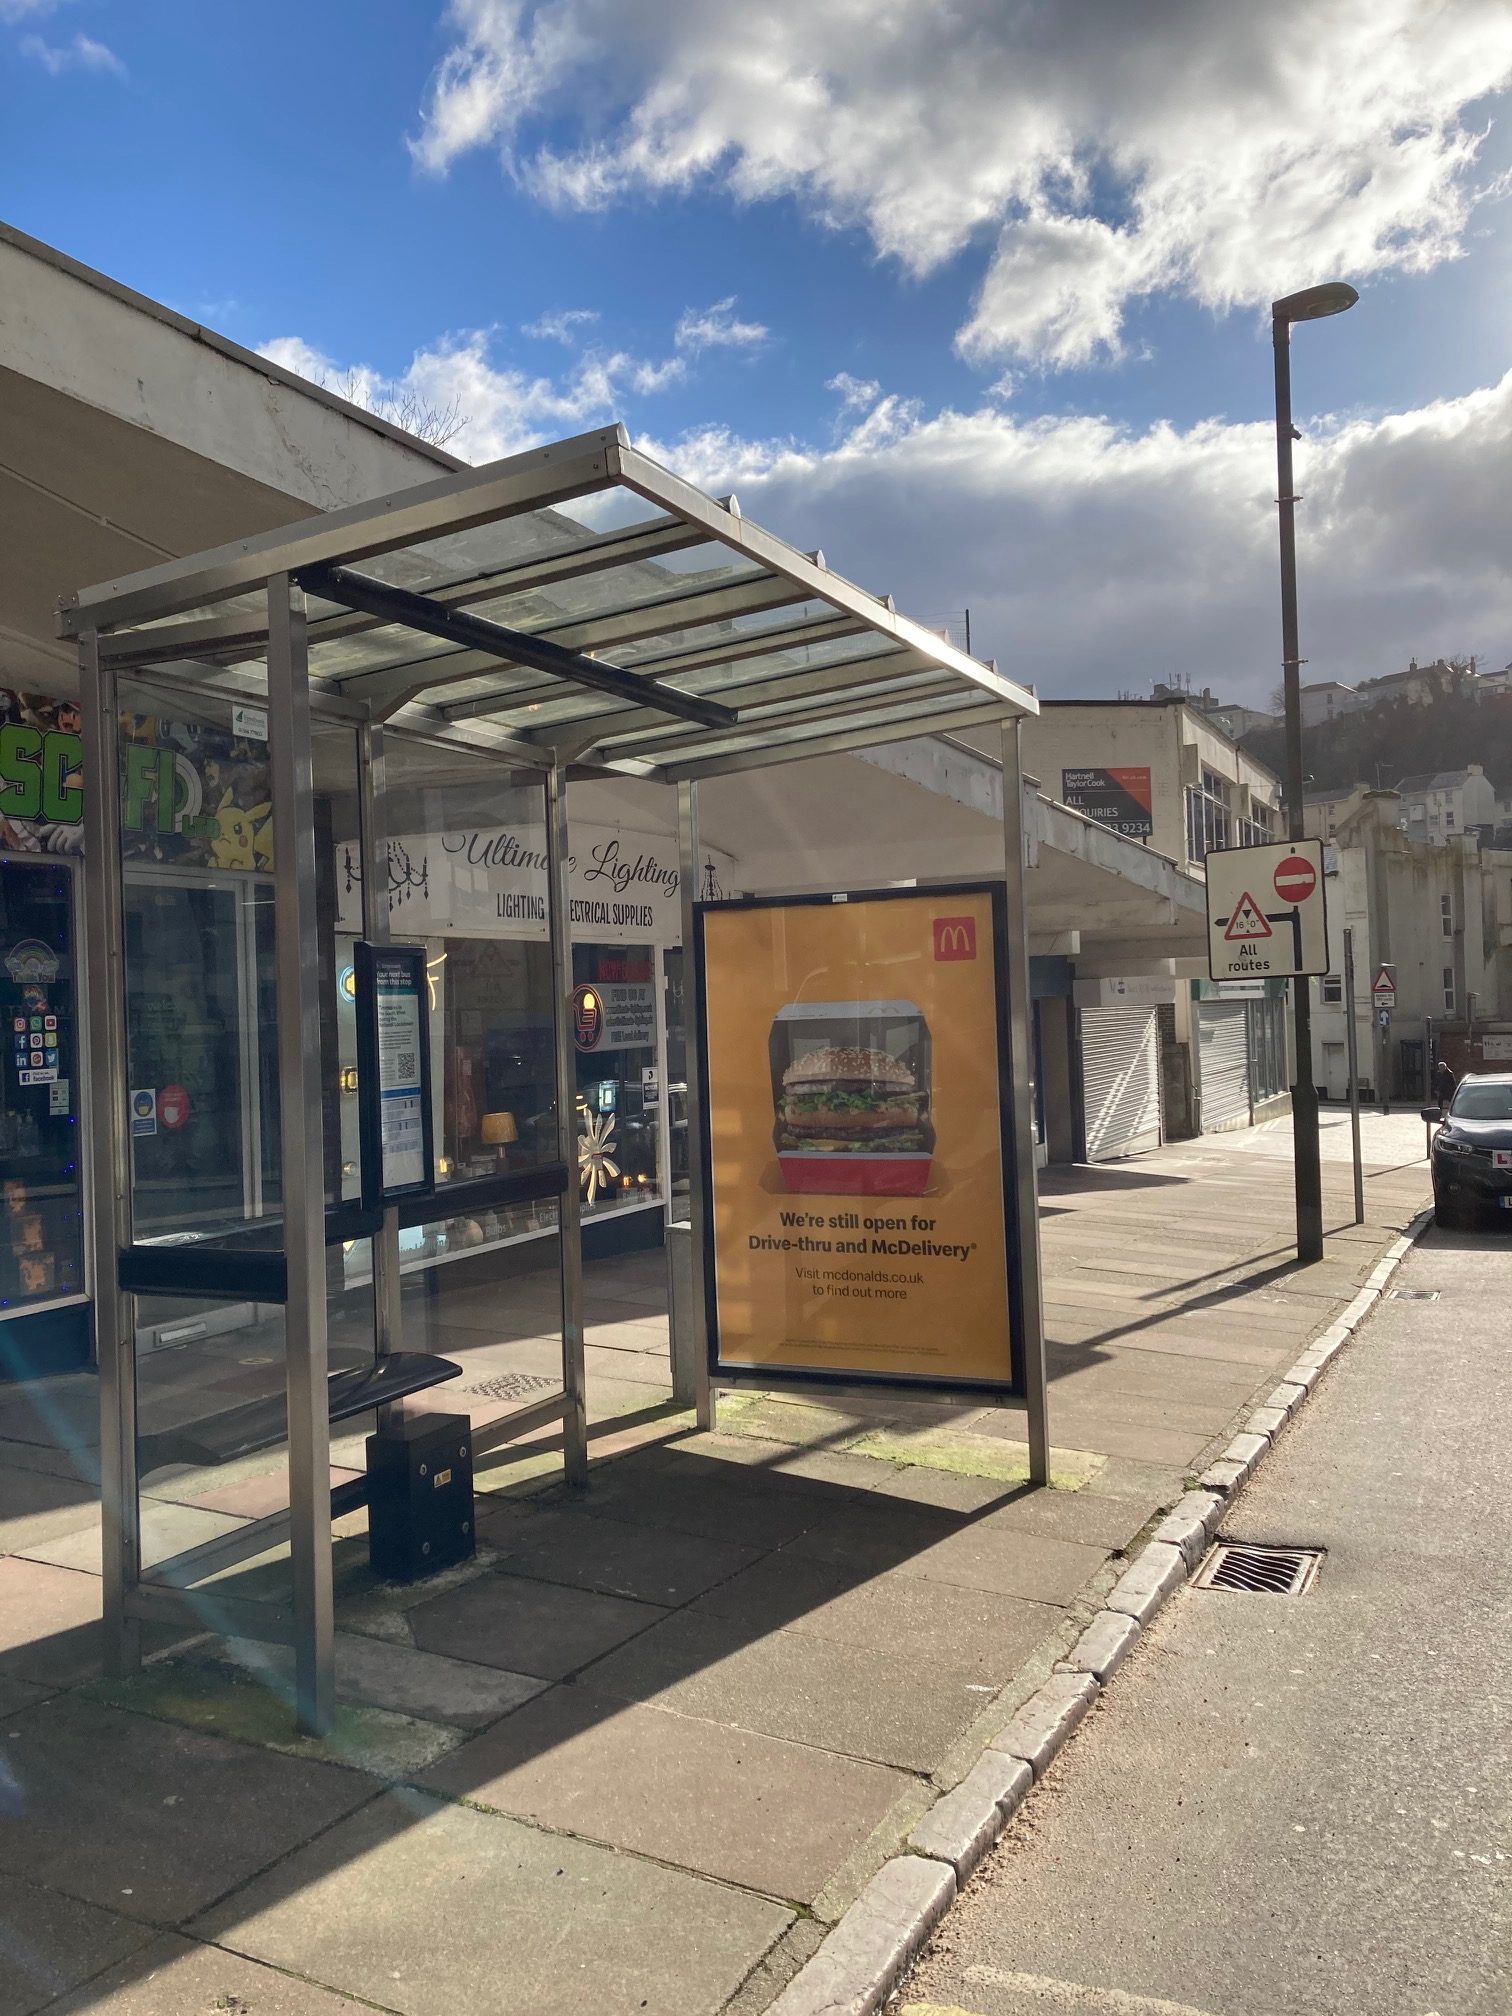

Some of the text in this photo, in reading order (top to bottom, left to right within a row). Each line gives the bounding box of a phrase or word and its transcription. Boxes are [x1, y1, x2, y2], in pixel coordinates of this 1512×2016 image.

[1065, 772, 1095, 780] Hartnell
[1066, 779, 1105, 789] Taylor Cook
[1065, 796, 1085, 805] ALL
[1079, 807, 1119, 817] QUIRIES
[1122, 823, 1150, 834] 9234
[583, 840, 681, 898] Lighting
[496, 892, 653, 927] LIGHTING ECTRICAL SUPPLIES
[1239, 943, 1258, 956] All
[1228, 960, 1270, 972] routes
[1497, 1153, 1508, 1164] L
[780, 1212, 937, 1234] We're still open for
[748, 1234, 832, 1254] Drive-thru
[836, 1239, 867, 1254] and
[795, 1267, 925, 1284] Visit mcdonalds.co.uk
[812, 1284, 907, 1300] to find out more
